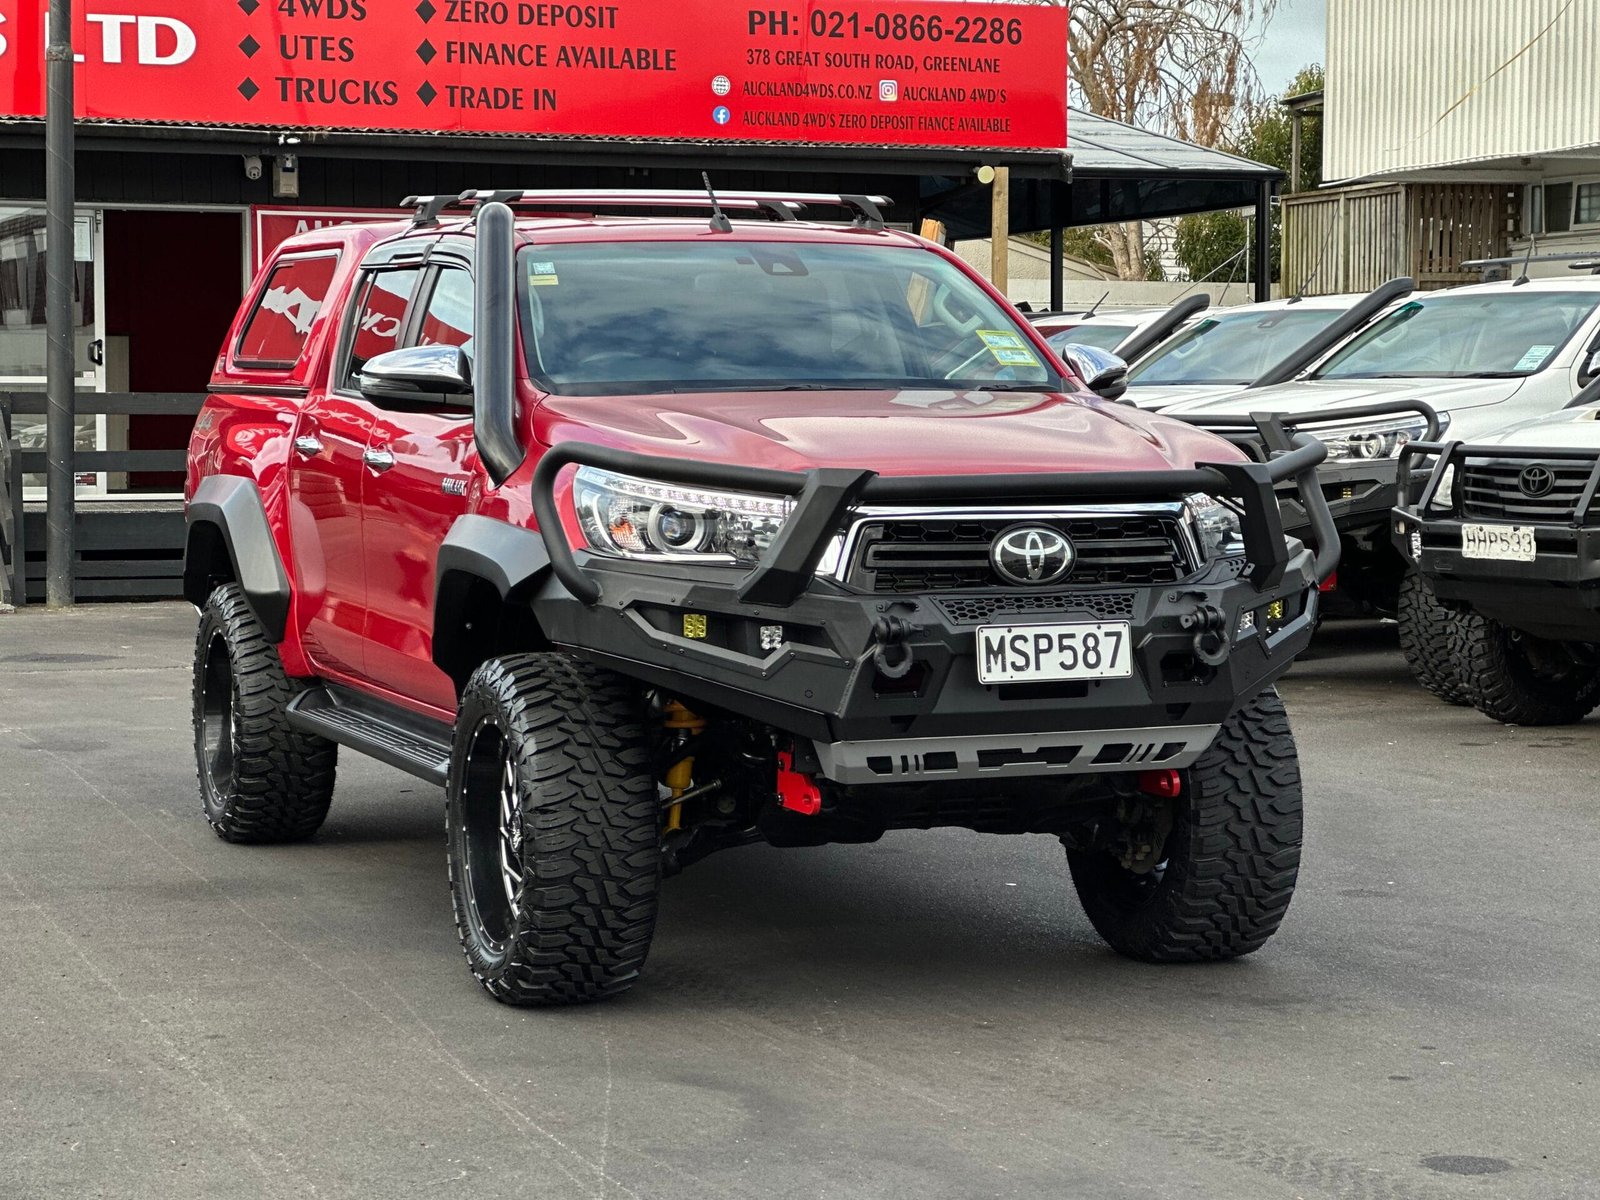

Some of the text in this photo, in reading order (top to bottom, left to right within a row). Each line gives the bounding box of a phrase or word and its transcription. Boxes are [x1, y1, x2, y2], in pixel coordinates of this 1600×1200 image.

[277, 0, 368, 21] 4WDS
[444, 0, 619, 29] ZERO DEPOSIT
[44, 12, 197, 66] TD
[748, 9, 1022, 45] PH: 021-0866-2286
[279, 34, 355, 63] UTES
[446, 40, 677, 71] FINANCE AVAILABLE
[746, 48, 1001, 73] 378 GREAT SOUTH ROAD, GREENLANE
[275, 76, 399, 106] TRUCKS
[445, 85, 557, 111] TRADE IN
[742, 80, 872, 100] AUCKLAND4WDS.CO.NZ
[902, 86, 1007, 104] AUCKLAND 4WD'S
[742, 111, 1011, 133] AUCKLAND 4WD'S ZERO DEPOSIT FIANCE AVAILABLE
[1466, 530, 1532, 553] HHP533
[984, 631, 1122, 673] MSP587
